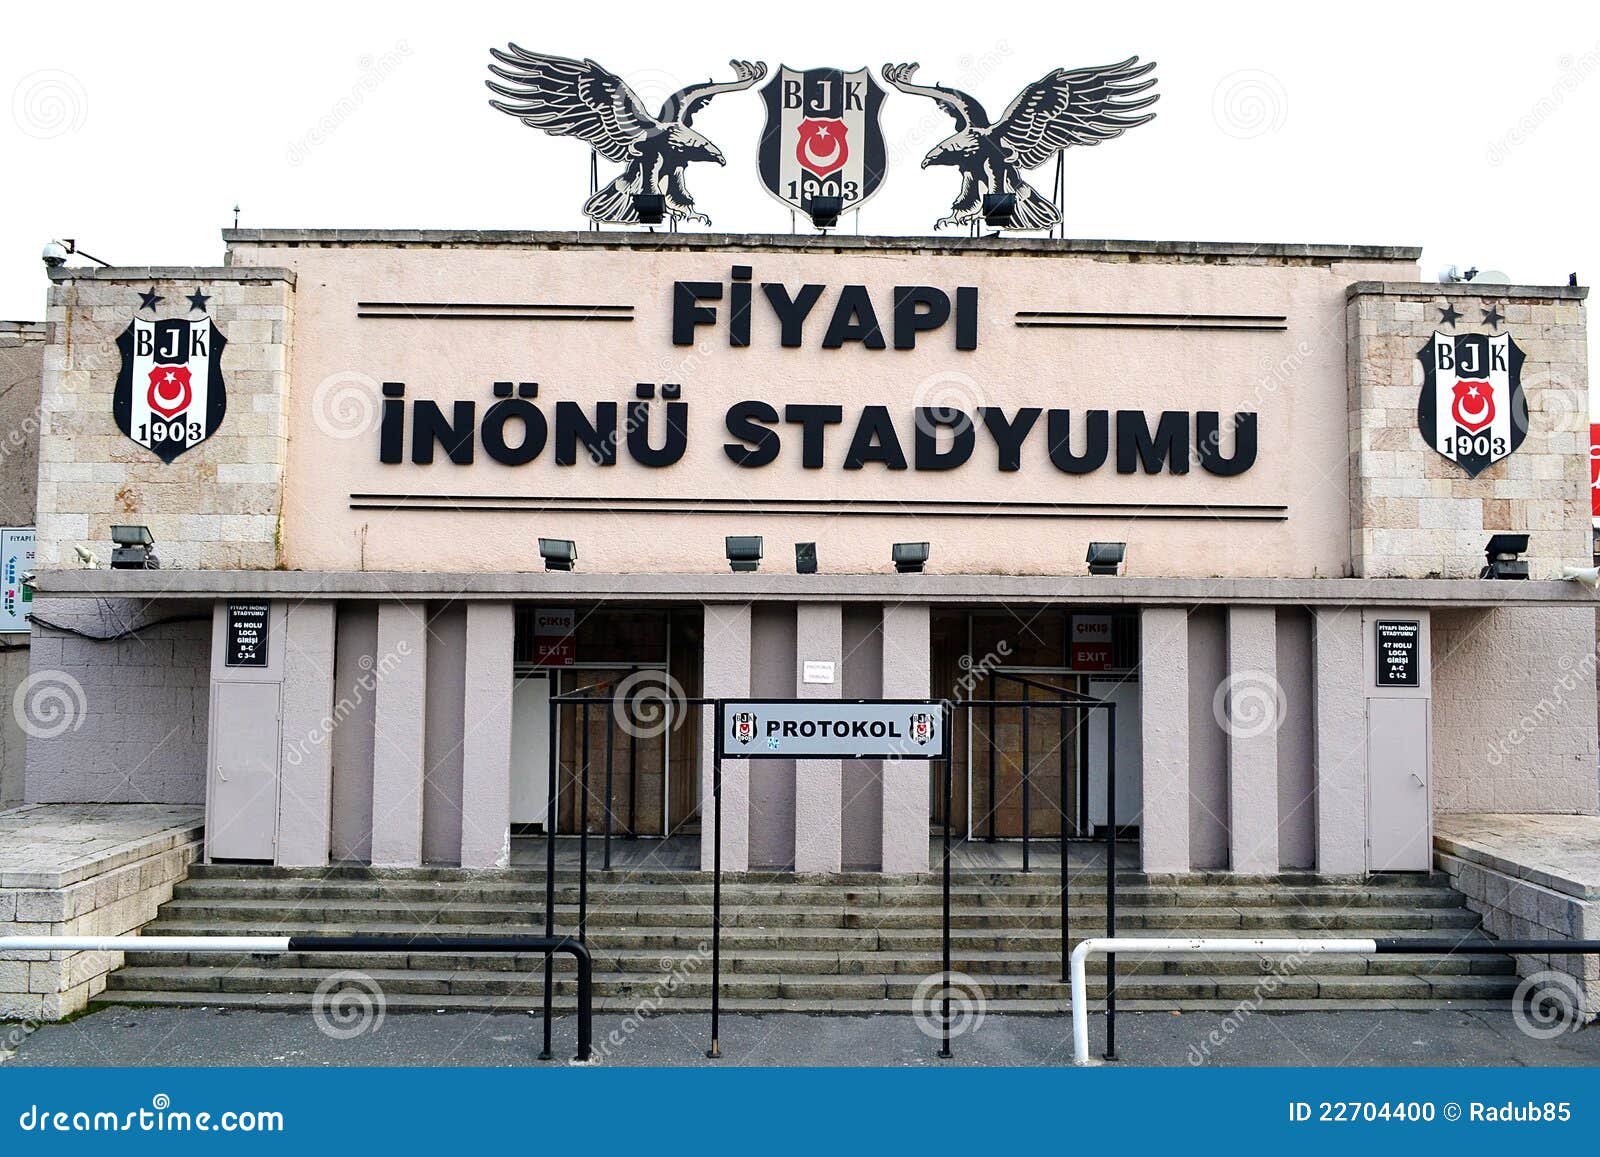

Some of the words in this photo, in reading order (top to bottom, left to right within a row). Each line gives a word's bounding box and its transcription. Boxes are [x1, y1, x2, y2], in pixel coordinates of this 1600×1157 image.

[787, 180, 859, 201] 1903
[673, 266, 978, 352] FİYAPI
[138, 422, 201, 442] 1903
[380, 382, 688, 469] İNÖNÜ
[724, 401, 1257, 478] STADYUMU
[1444, 435, 1505, 455] 1903
[539, 646, 569, 655] EXIT
[1077, 651, 1107, 661] EXIT
[767, 720, 902, 738] PROTOKOL
